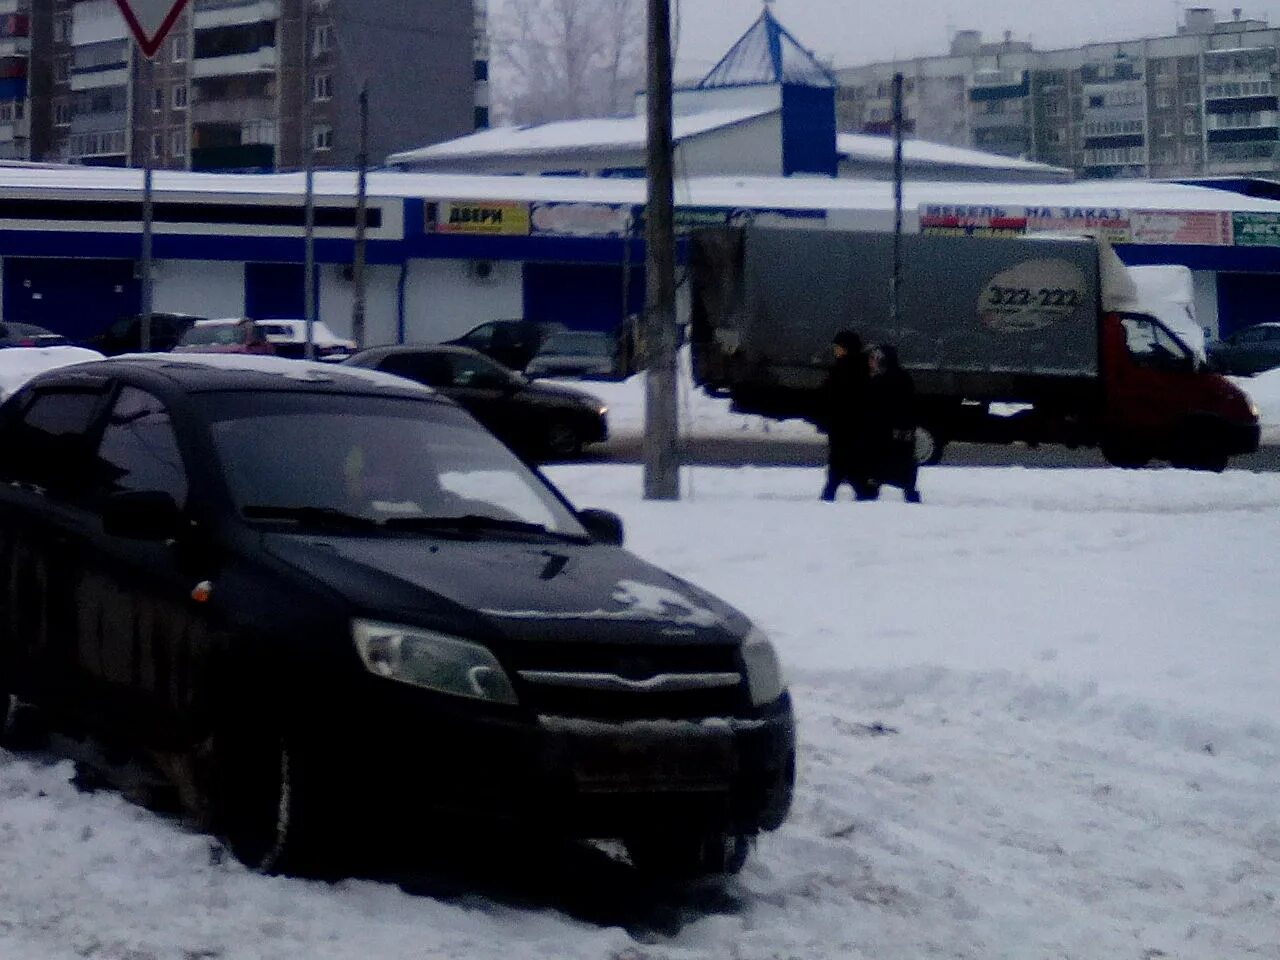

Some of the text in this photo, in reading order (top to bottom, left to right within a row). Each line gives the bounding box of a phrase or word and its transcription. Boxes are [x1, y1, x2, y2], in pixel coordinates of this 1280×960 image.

[450, 207, 503, 224] ДВЕРИ
[927, 205, 1122, 220] МЕБЕЛЬ НА ЗАКАЗ
